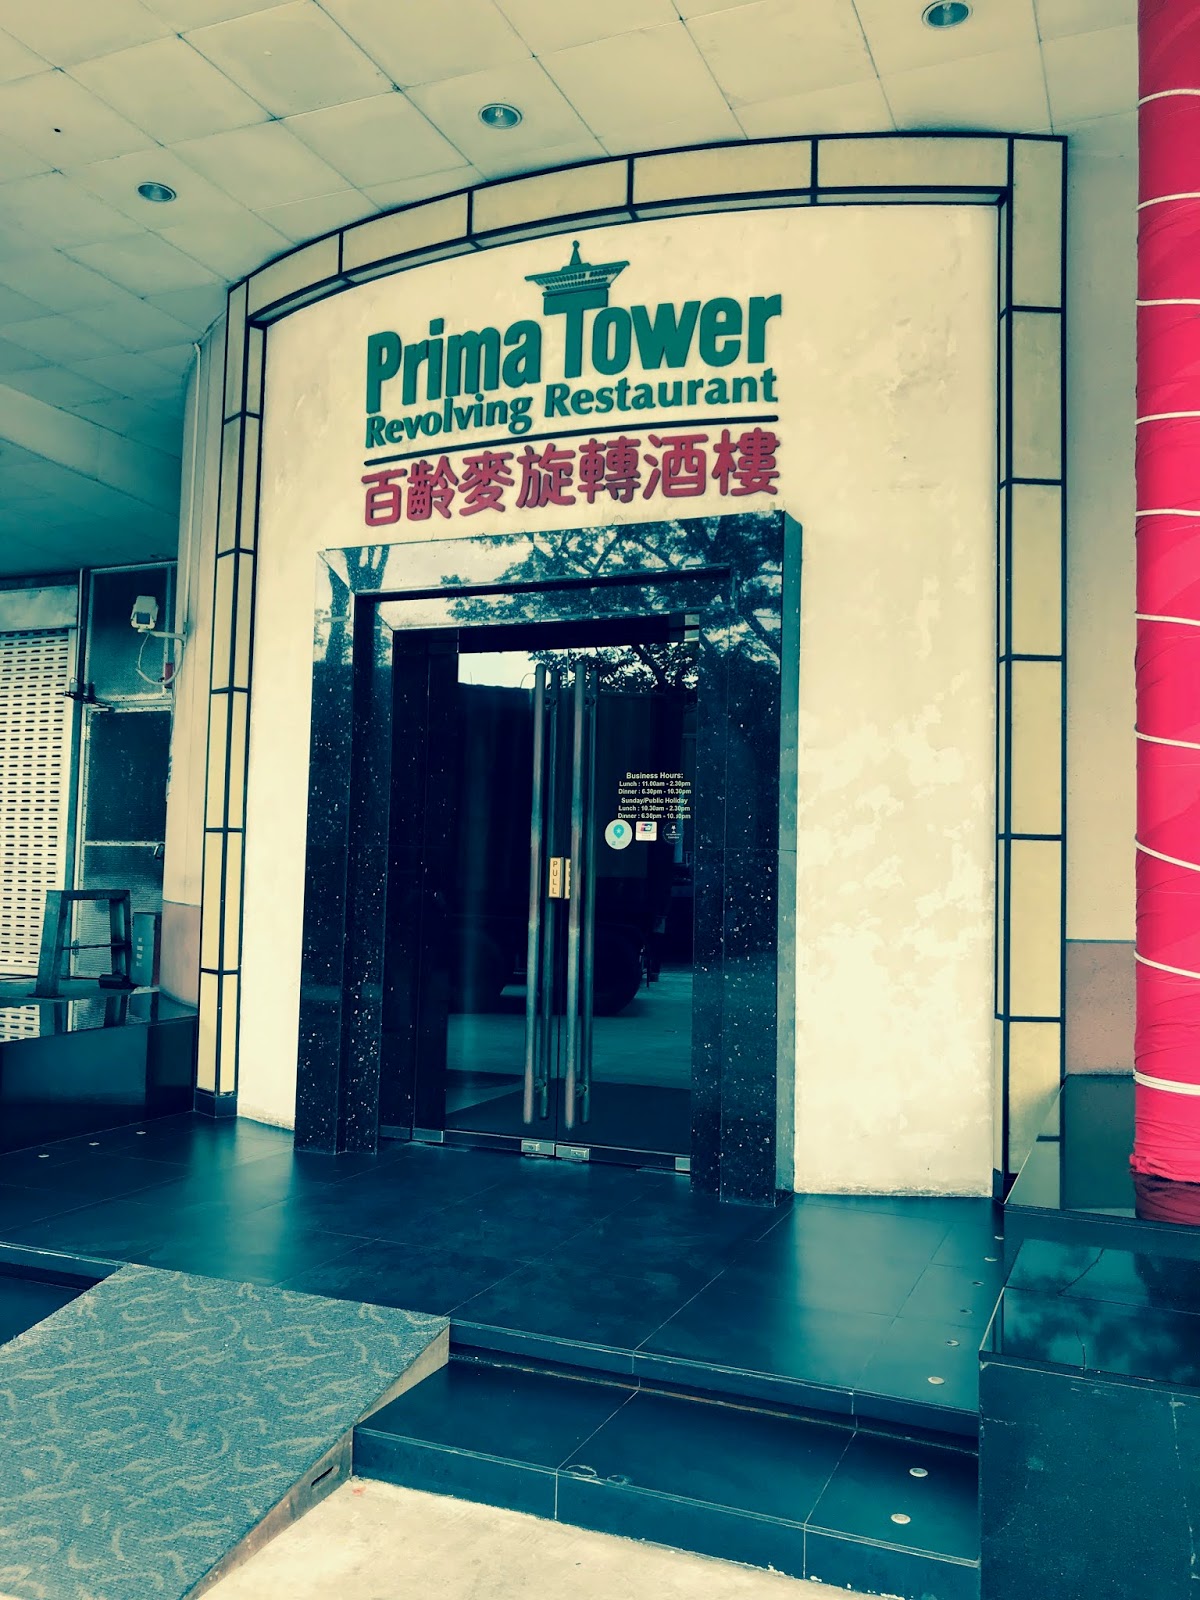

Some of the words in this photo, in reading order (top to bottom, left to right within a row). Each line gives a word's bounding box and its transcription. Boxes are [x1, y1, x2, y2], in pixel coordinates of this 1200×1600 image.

[366, 317, 542, 414] Prima
[542, 287, 782, 379] Tower
[365, 394, 534, 449] Revolving
[544, 367, 779, 419] Restaurant
[361, 426, 781, 527] 百齡麥旋轉酒樓
[669, 780, 691, 788] 2.30pm
